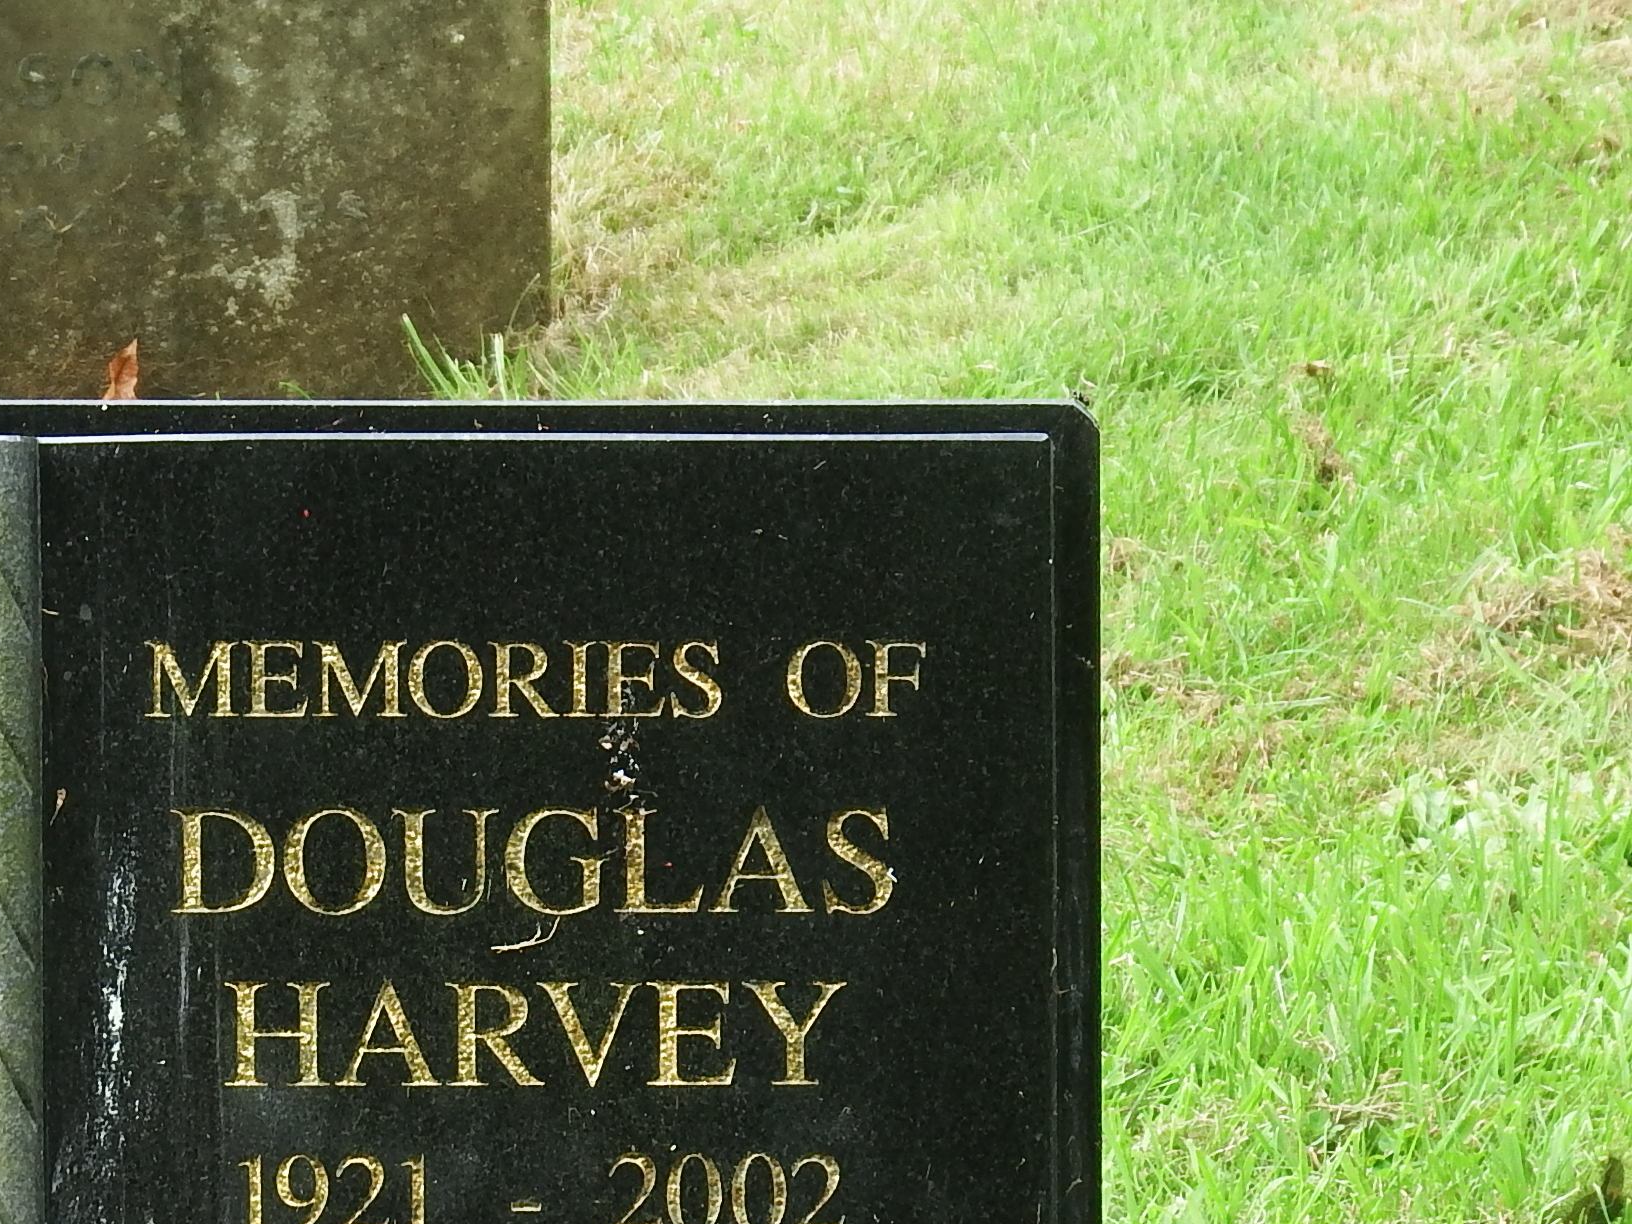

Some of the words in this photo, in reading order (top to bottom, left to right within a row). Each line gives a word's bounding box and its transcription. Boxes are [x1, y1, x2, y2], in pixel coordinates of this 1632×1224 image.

[143, 639, 723, 720] MEMORIES
[786, 640, 927, 719] OF
[170, 804, 897, 917] DOUGLAS
[223, 980, 848, 1089] HARVEY
